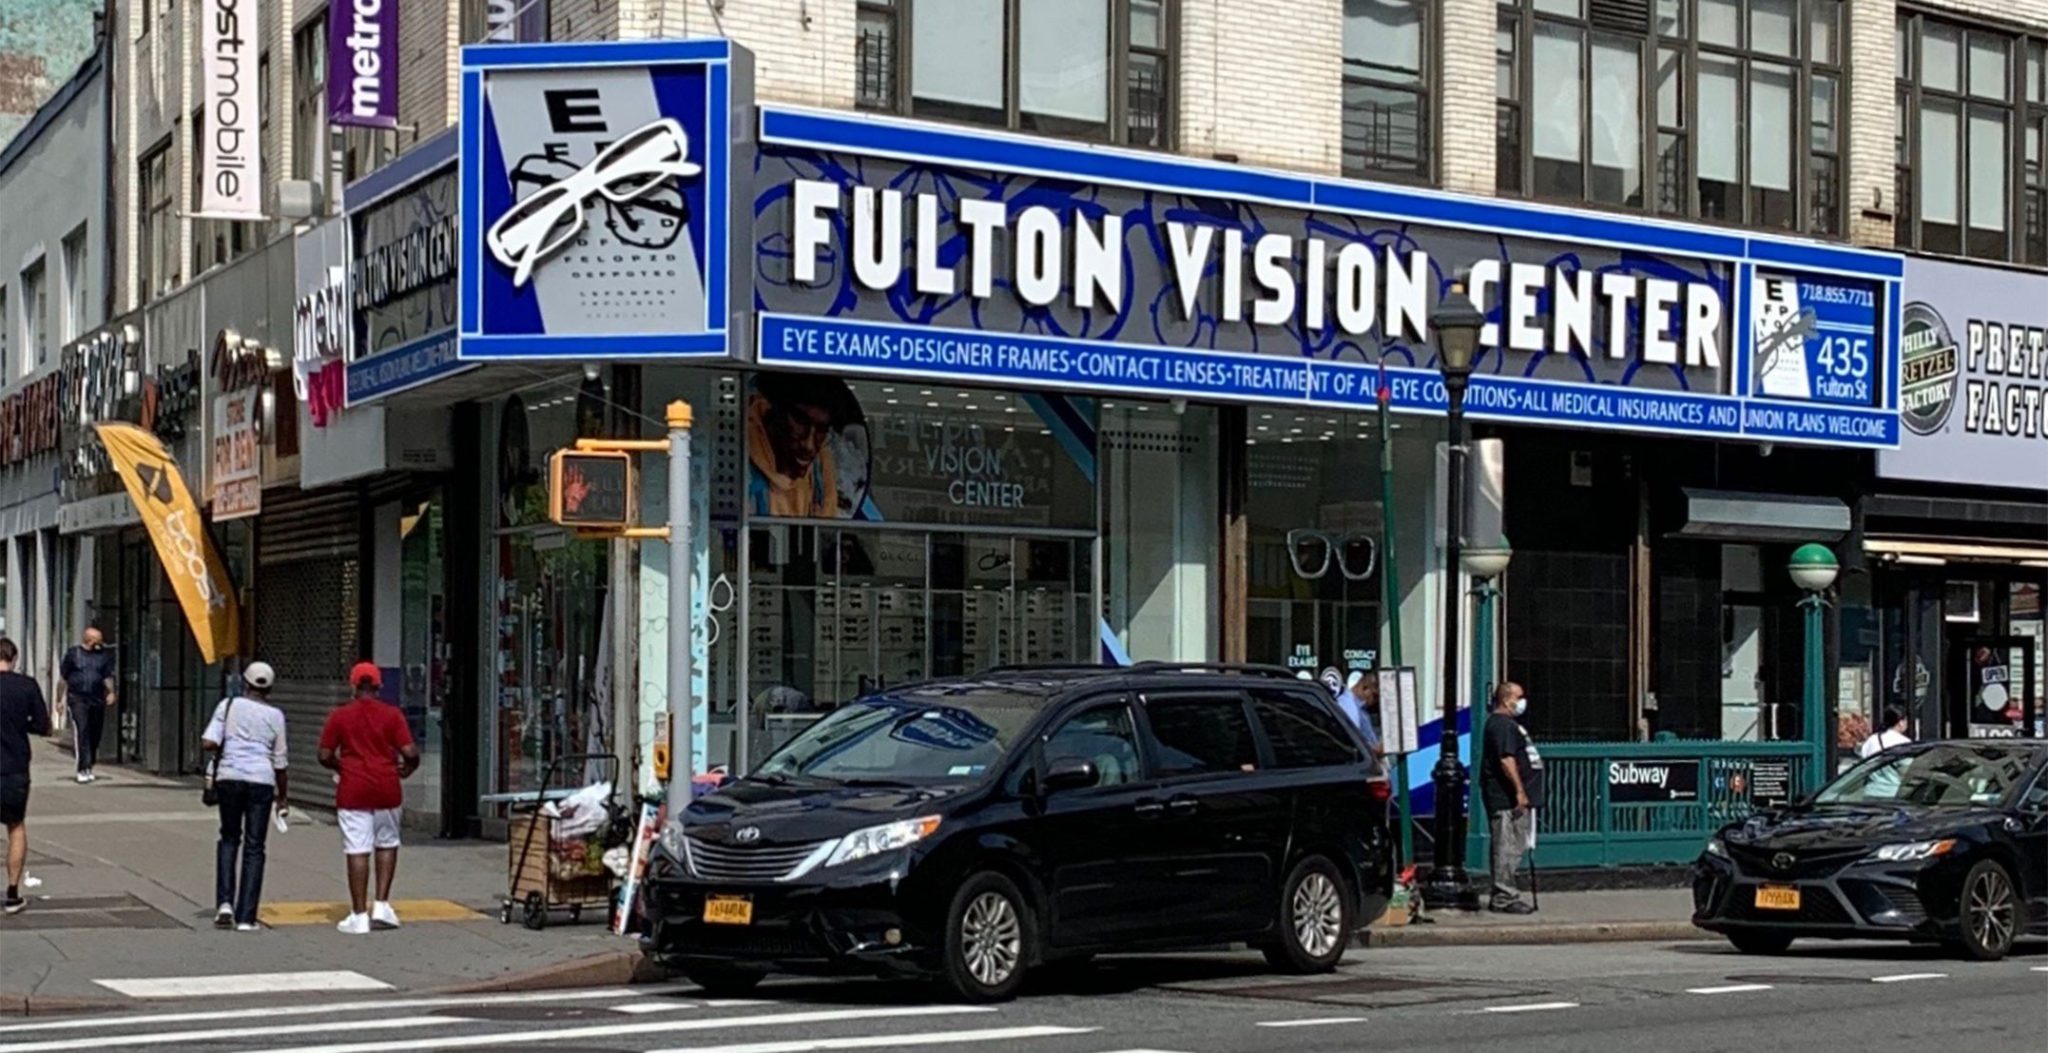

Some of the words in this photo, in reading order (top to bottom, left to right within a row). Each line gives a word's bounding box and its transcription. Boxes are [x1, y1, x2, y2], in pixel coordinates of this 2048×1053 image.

[346, 0, 382, 117] metro
[543, 88, 608, 133] E
[794, 179, 1122, 315] FULTON
[1167, 221, 1428, 343] VISION
[1469, 259, 1721, 368] CENTER
[1766, 279, 1783, 301] E
[1802, 283, 1875, 307] 718.855.7711
[1817, 336, 1869, 377] 435
[1967, 318, 2048, 381] PRET
[783, 328, 817, 353] EYE
[824, 331, 892, 360] EXAMS
[900, 337, 992, 367] DESIGNER
[998, 348, 1070, 374] FRAMES
[1077, 351, 1160, 381] CONTACT
[1165, 360, 1226, 386] LENSES
[1232, 364, 1330, 394] TREATMENT
[1333, 373, 1356, 395] OF
[1359, 376, 1384, 400] AL
[1392, 378, 1420, 401] EYE
[1423, 381, 1517, 409] COITIONS
[1522, 389, 1549, 412] ALL
[1552, 392, 1614, 417] MEDICAL
[1618, 398, 1703, 424] INSURANCES
[1708, 405, 1738, 427] AND
[1743, 408, 1784, 430] UNION
[1787, 411, 1826, 434] PLANS
[1828, 415, 1886, 439] WELCOME
[1816, 376, 1854, 399] Fulton
[1855, 379, 1868, 401] St
[1965, 379, 2048, 439] FACT
[925, 445, 1002, 475] VISION
[949, 480, 1025, 508] CENTER
[1609, 763, 1669, 788] Subway
